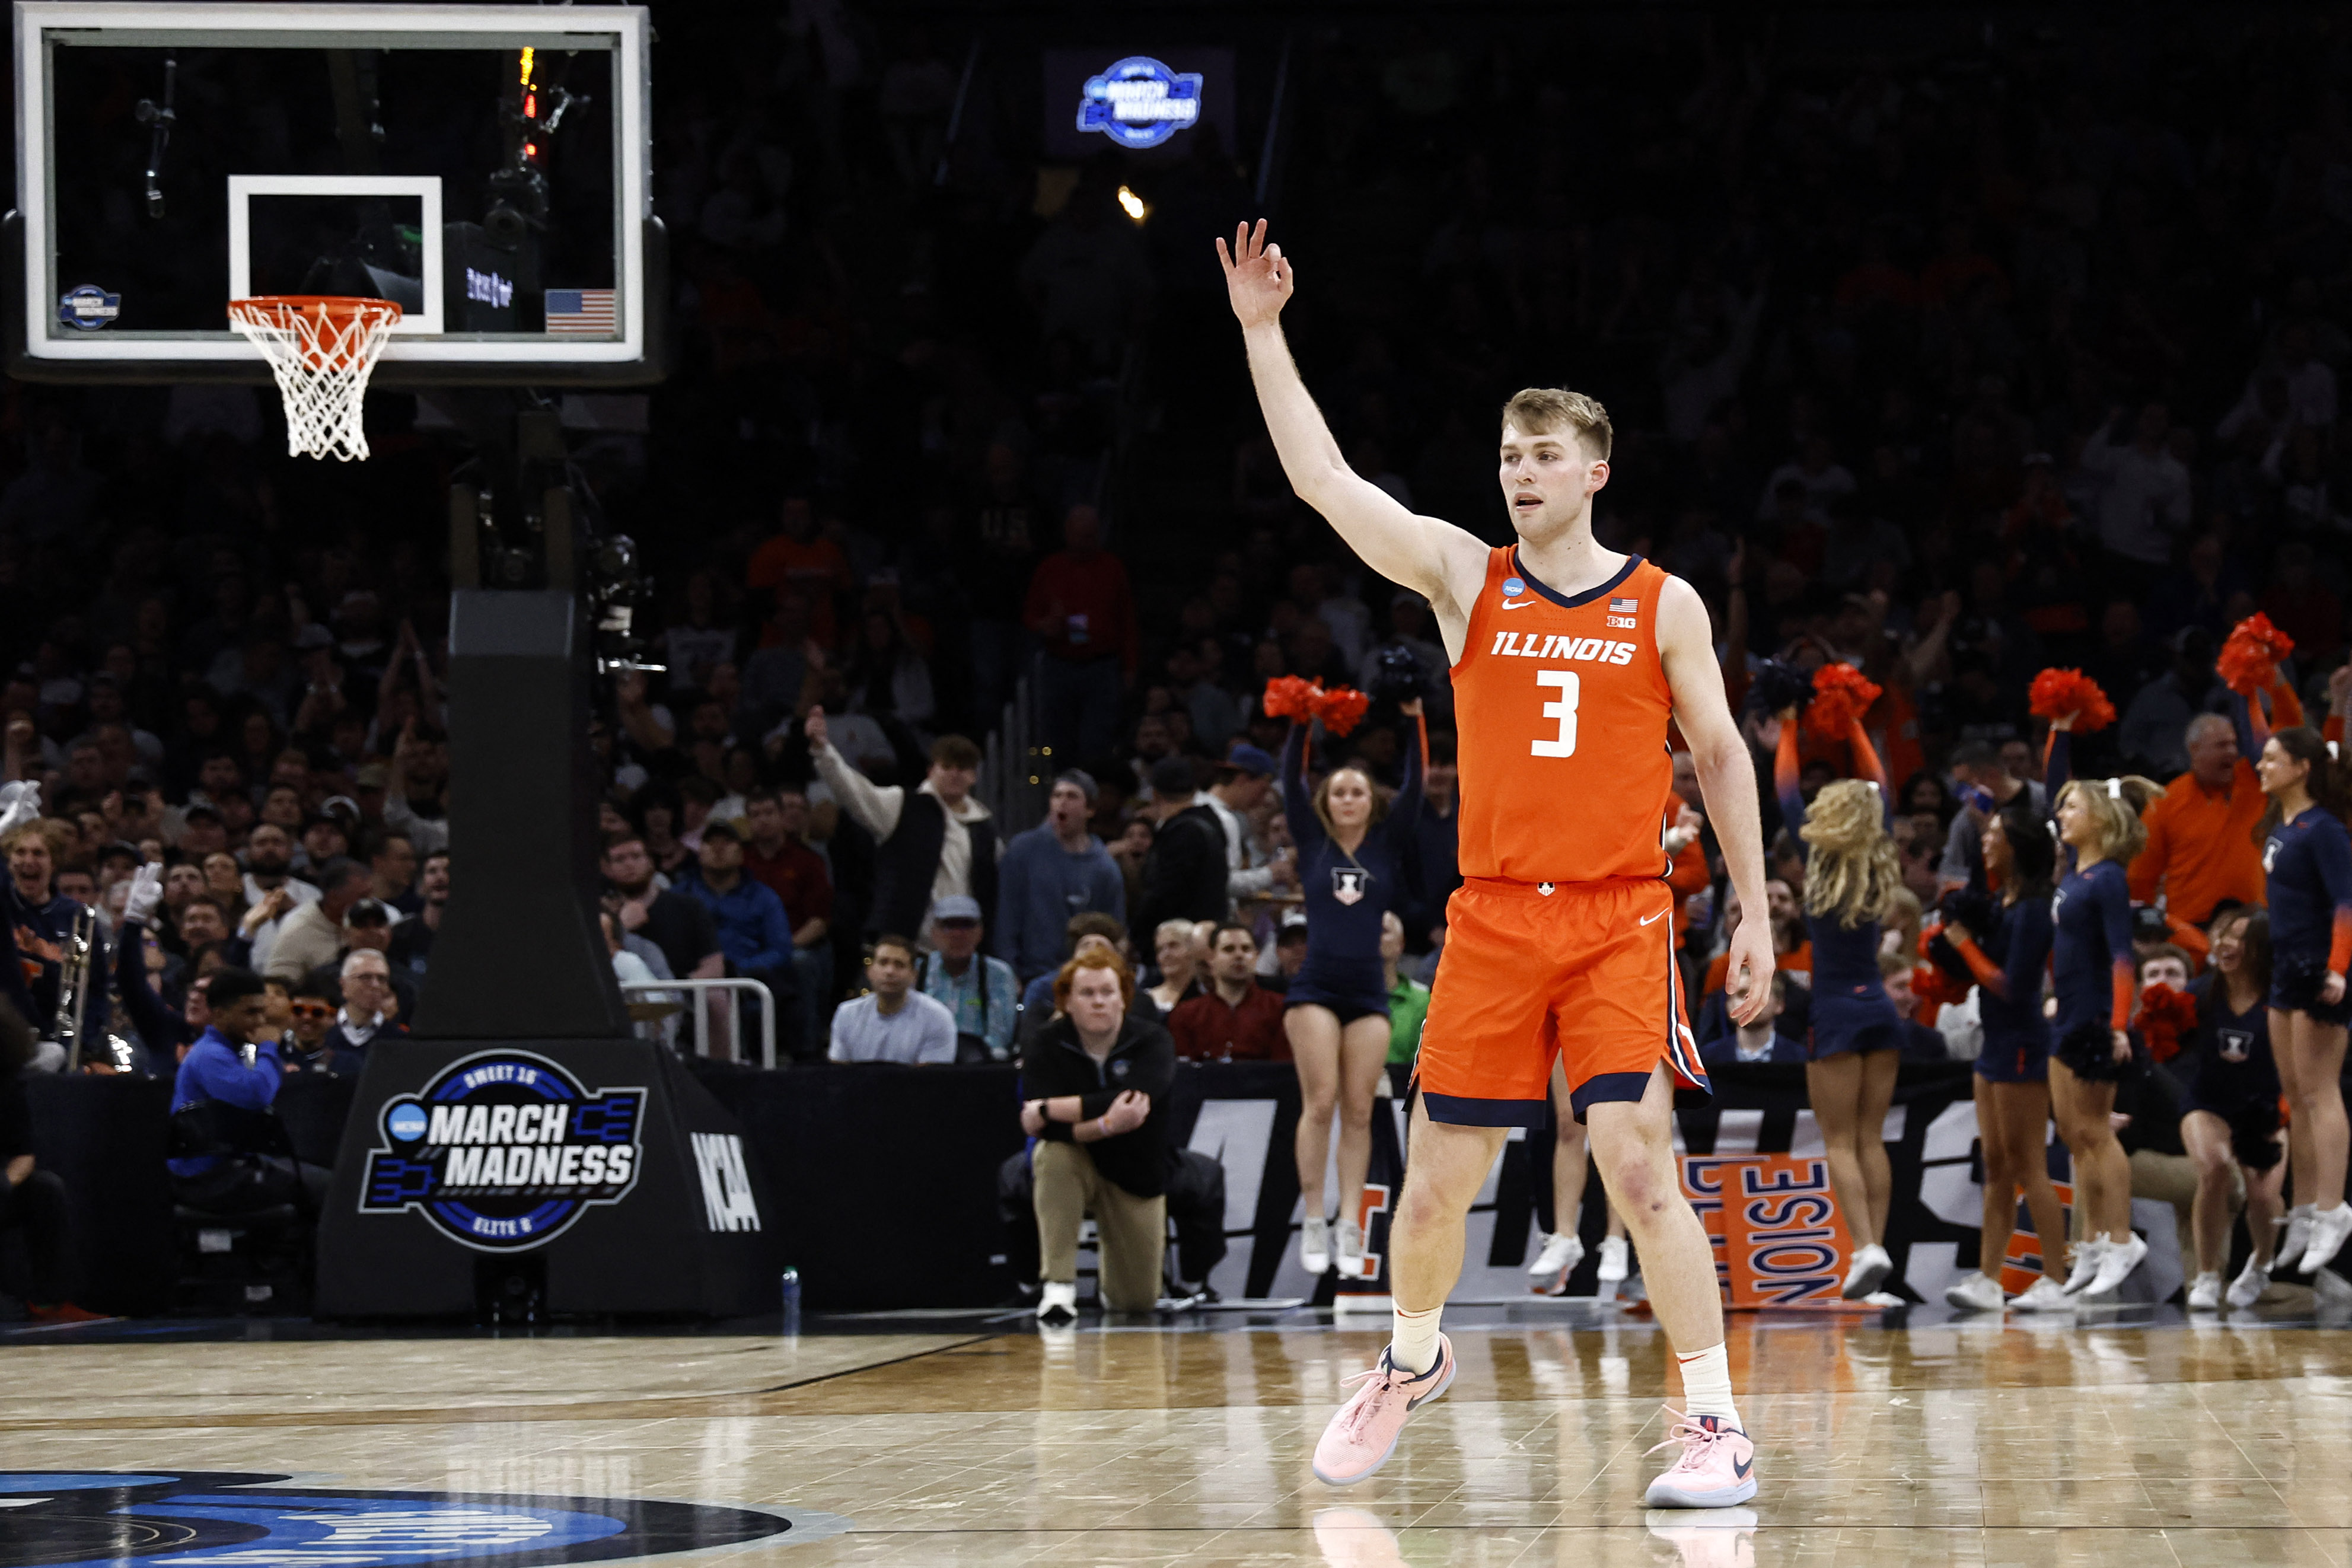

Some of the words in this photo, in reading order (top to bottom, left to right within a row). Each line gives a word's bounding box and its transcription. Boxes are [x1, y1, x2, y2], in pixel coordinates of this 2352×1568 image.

[1490, 630, 1637, 665] ILLINOIS
[1531, 670, 1580, 758] 3
[463, 1065, 515, 1089] SWEET
[427, 1104, 571, 1145] MARCH
[444, 1145, 635, 1186] MADNESS
[473, 1216, 517, 1236] ELITE
[1741, 1159, 1842, 1305] NOISE
